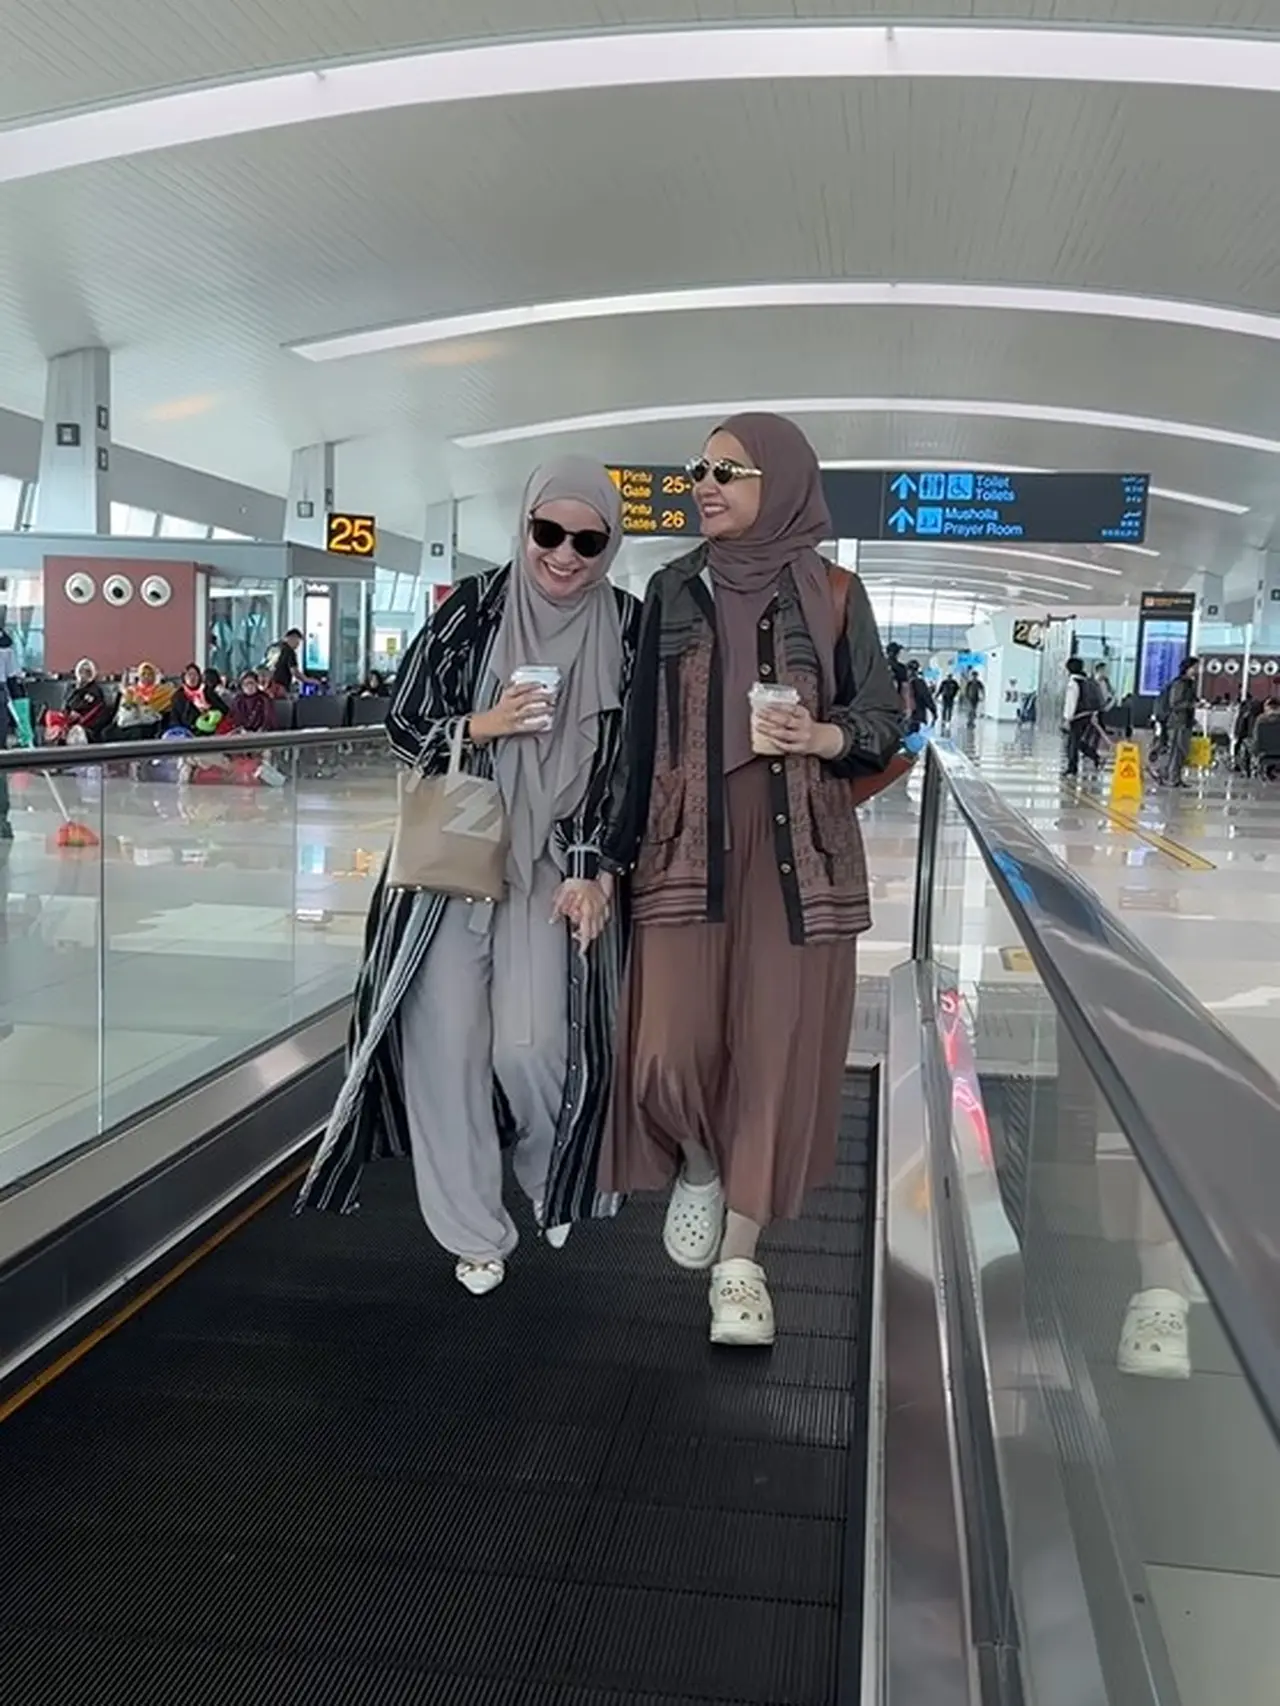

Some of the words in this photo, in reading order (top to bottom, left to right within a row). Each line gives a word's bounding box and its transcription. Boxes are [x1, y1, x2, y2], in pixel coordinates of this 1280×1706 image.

[976, 475, 1009, 488] Toilet
[976, 488, 1016, 501] Toilets
[662, 510, 685, 528] 26
[329, 516, 375, 553] 25
[943, 521, 983, 537] Prayer
[985, 522, 1024, 536] Room
